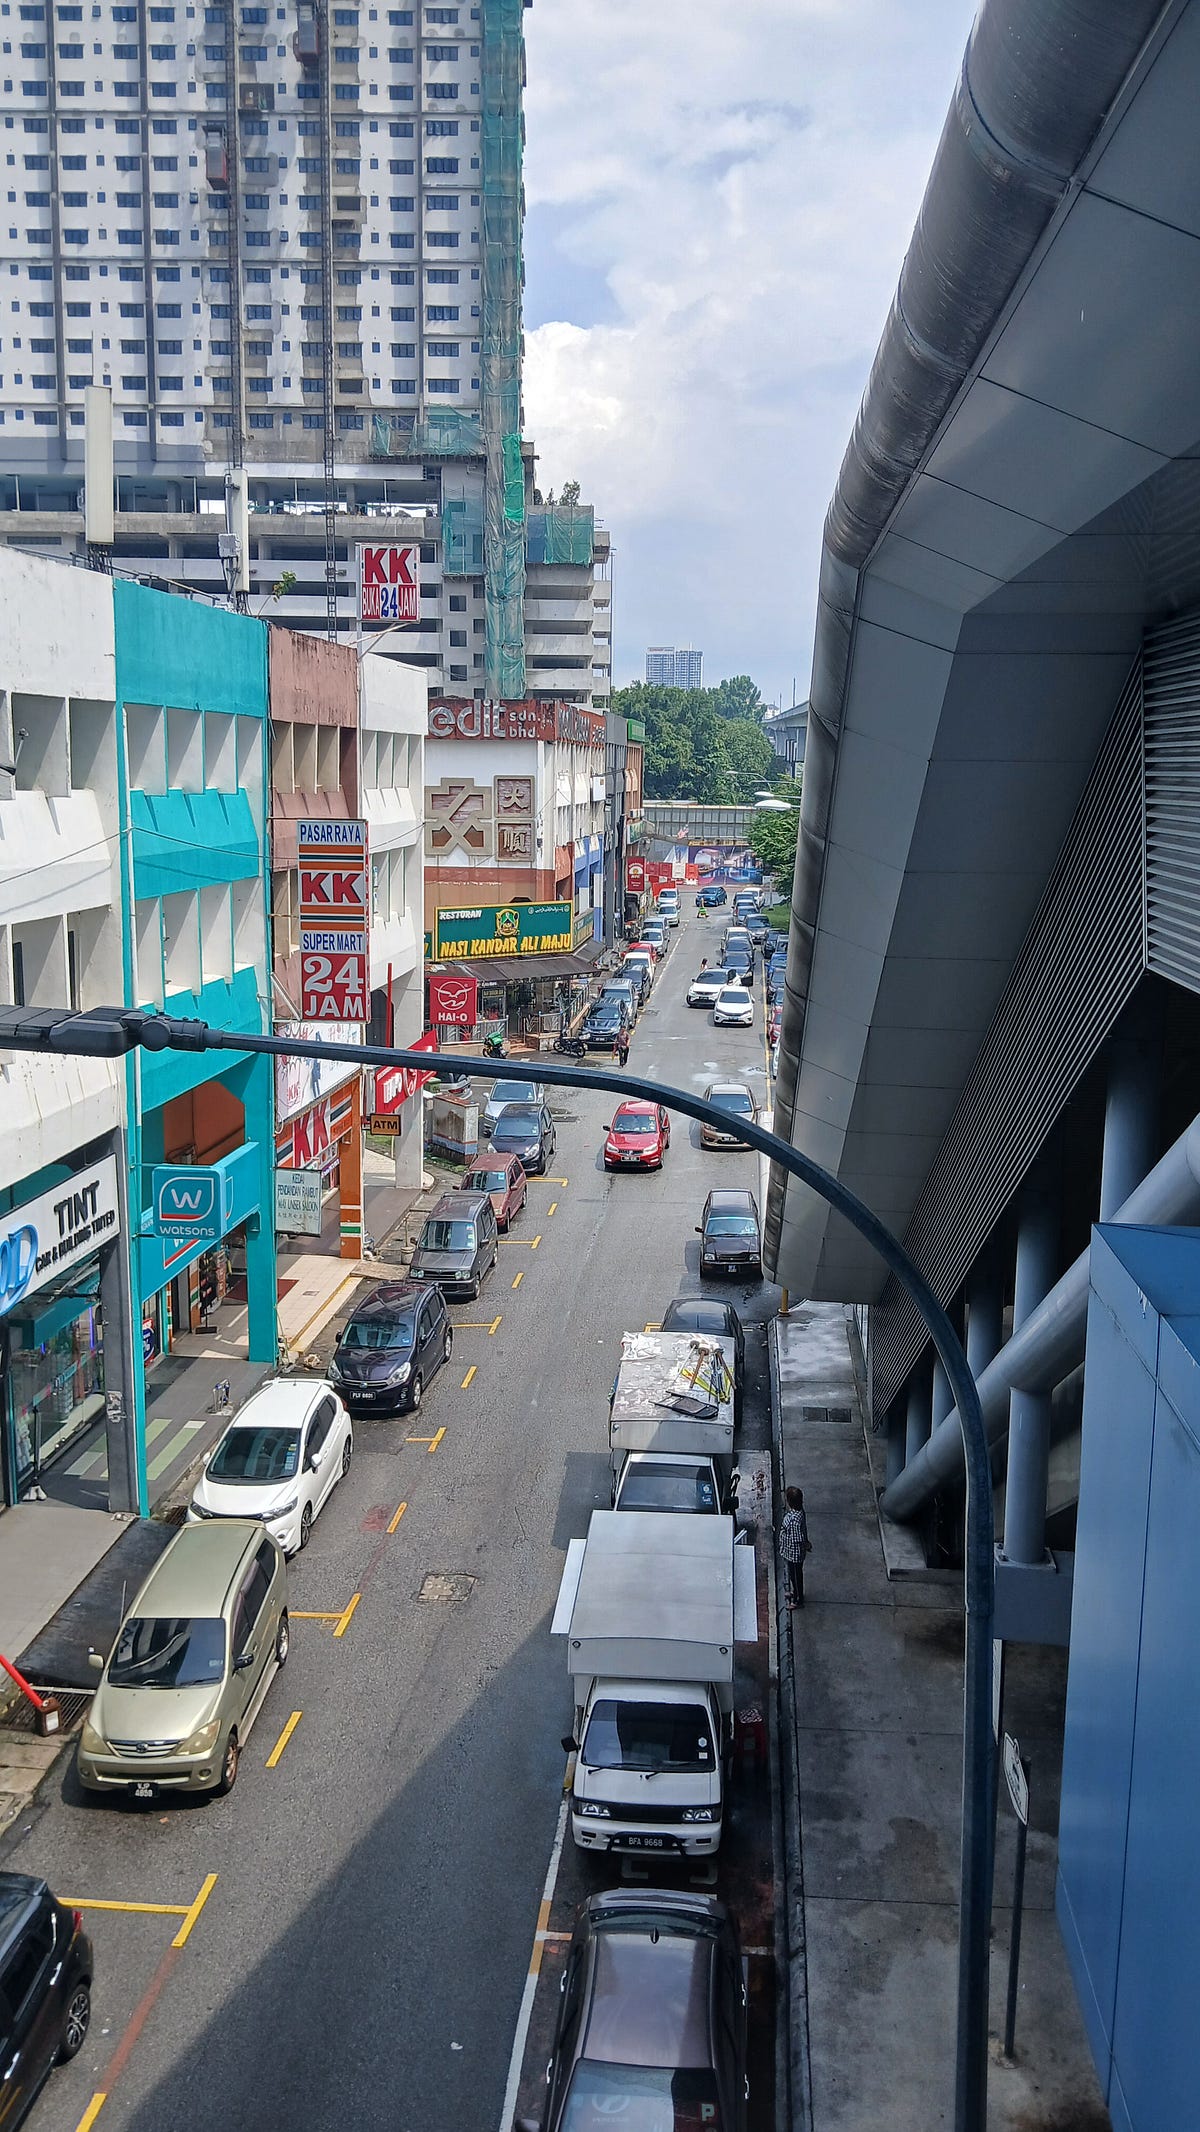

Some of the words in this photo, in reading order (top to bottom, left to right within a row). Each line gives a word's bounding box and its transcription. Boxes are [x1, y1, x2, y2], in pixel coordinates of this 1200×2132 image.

[365, 548, 413, 583] KK
[363, 587, 379, 616] BUKA
[381, 587, 397, 617] 24
[399, 587, 416, 616] JAM
[509, 709, 541, 722] sdn.
[509, 726, 541, 739] bhd.
[302, 872, 361, 903] KK
[439, 909, 482, 920] RESTORAN
[440, 941, 468, 957] NASI
[470, 937, 517, 955] KANDAR
[520, 935, 538, 951] ALI
[540, 933, 571, 950] MAJU
[304, 956, 364, 993] 24
[304, 994, 364, 1017] JAM
[438, 1012, 468, 1022] HAI-O
[294, 1099, 329, 1168] KK
[373, 1120, 398, 1130] ATM
[54, 1180, 99, 1236] TINT
[160, 1226, 215, 1236] watsons
[51, 1245, 58, 1261] &
[628, 1837, 642, 1845] BFA
[701, 2104, 714, 2121] P
